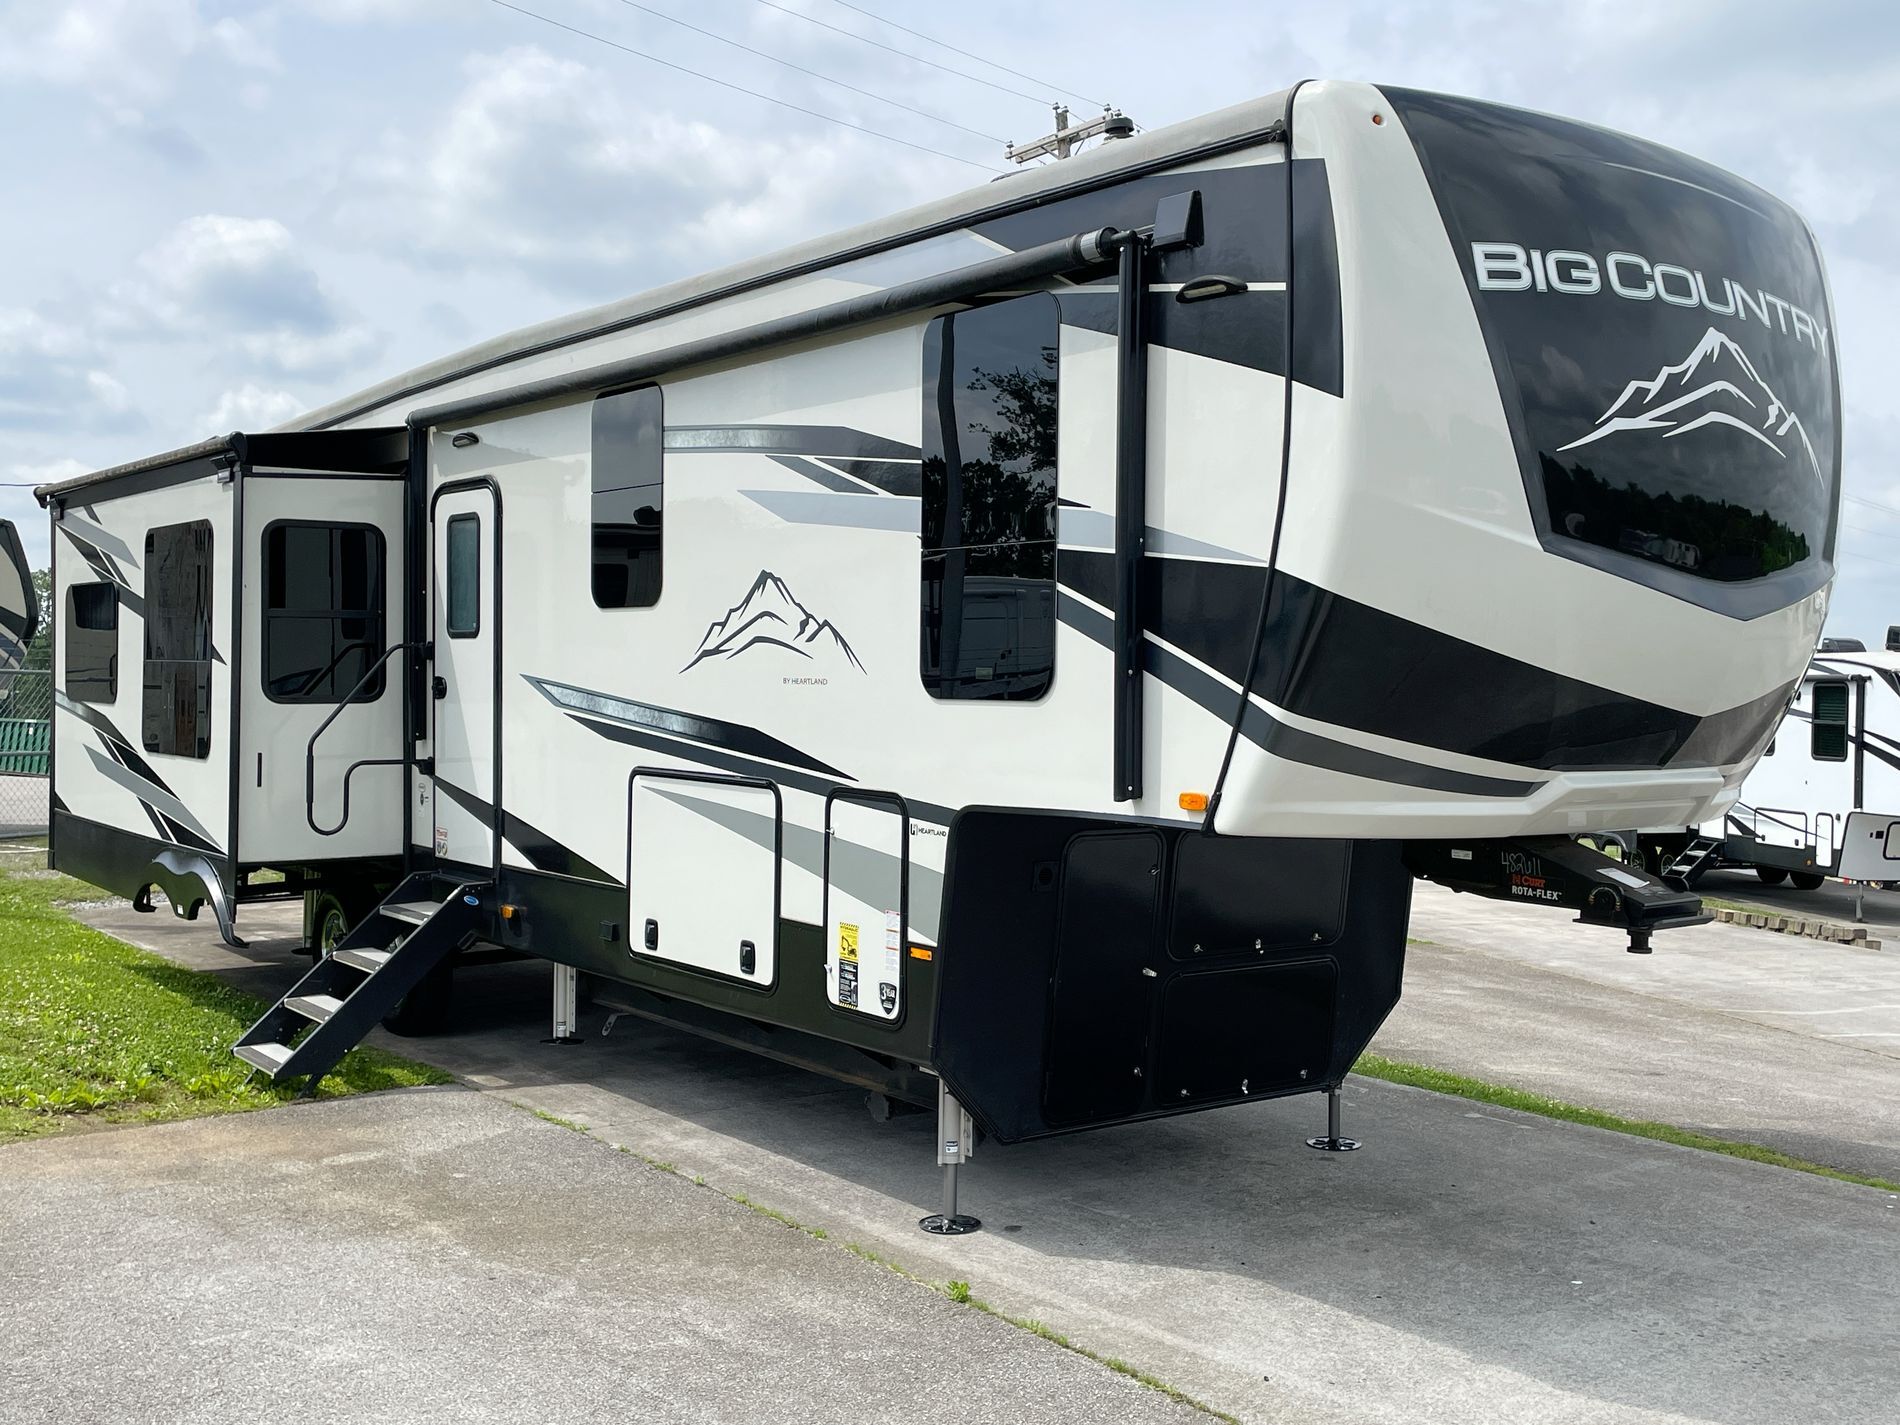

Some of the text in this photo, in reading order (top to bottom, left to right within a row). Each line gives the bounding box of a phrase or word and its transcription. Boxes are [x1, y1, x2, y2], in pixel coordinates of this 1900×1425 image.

[1471, 241, 1829, 358] BIG COUNTRY
[782, 677, 828, 686] BY HEARTLAND
[918, 827, 947, 838] HEARTLAND
